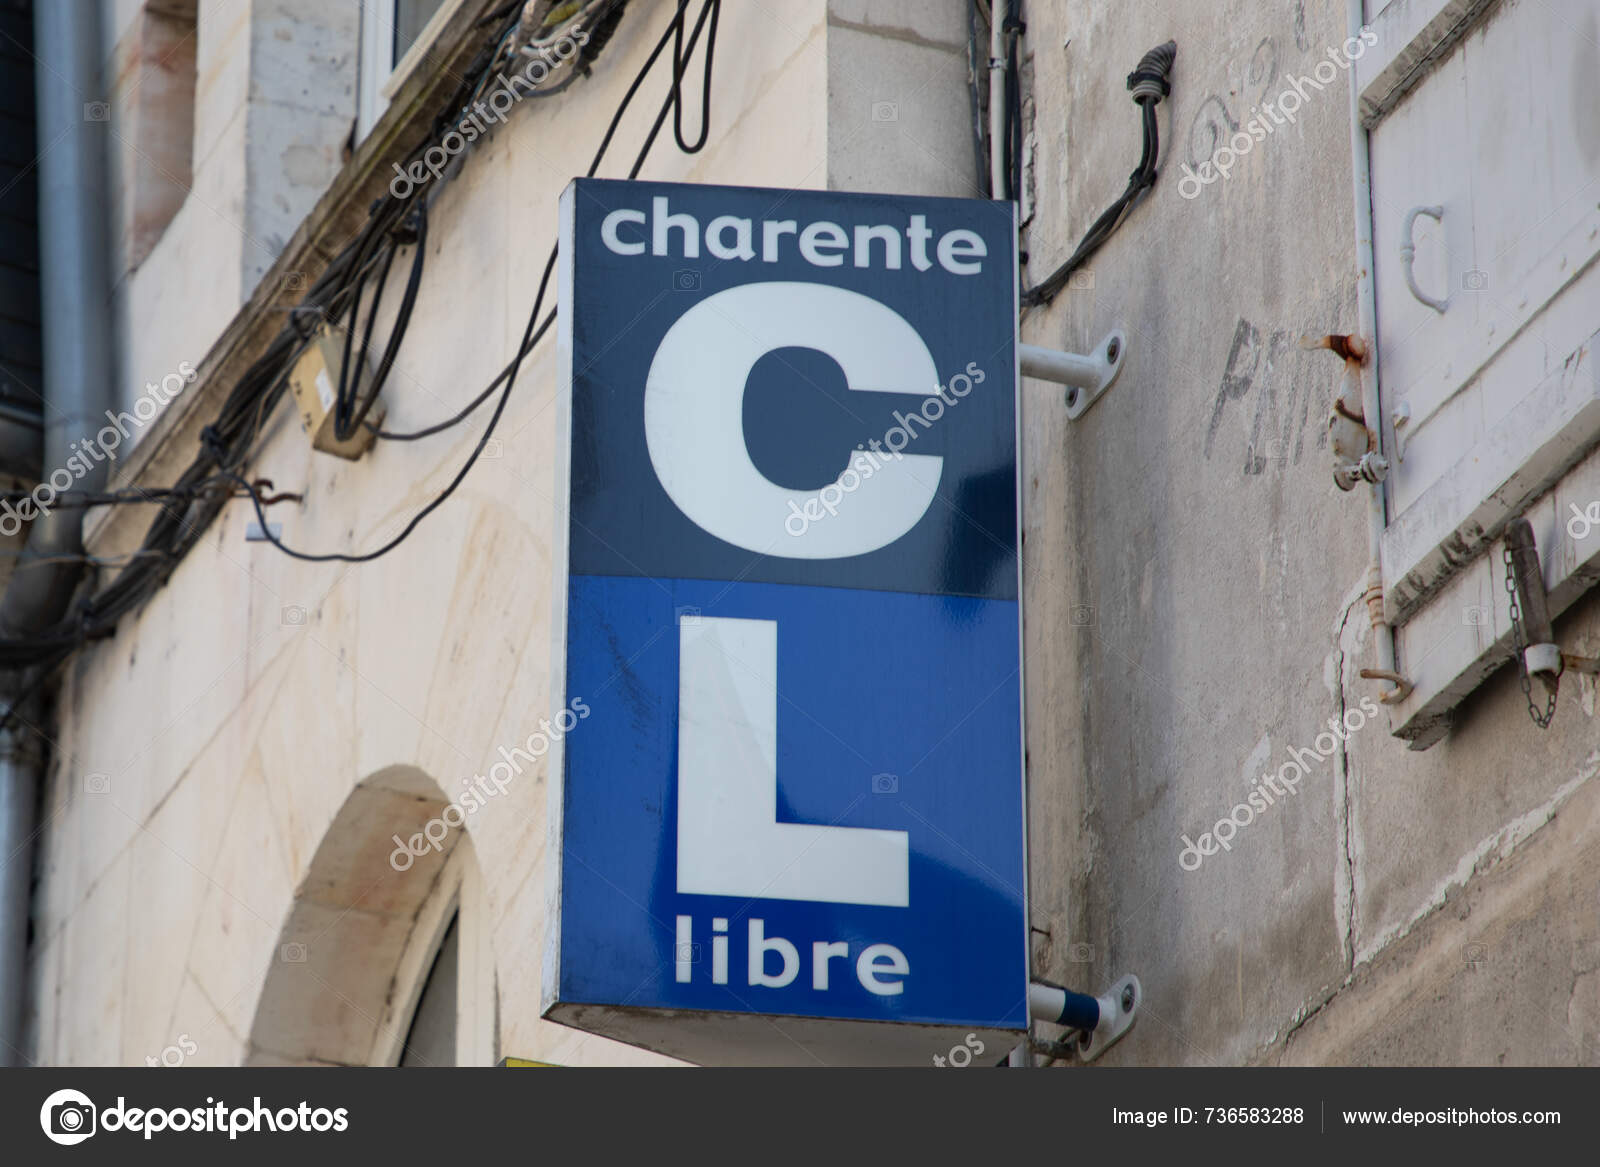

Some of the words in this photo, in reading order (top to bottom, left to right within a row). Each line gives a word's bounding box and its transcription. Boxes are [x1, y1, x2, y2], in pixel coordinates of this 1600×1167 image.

[600, 196, 988, 275] charente
[644, 281, 944, 560] C
[677, 615, 910, 907] L
[675, 915, 910, 996] libre
